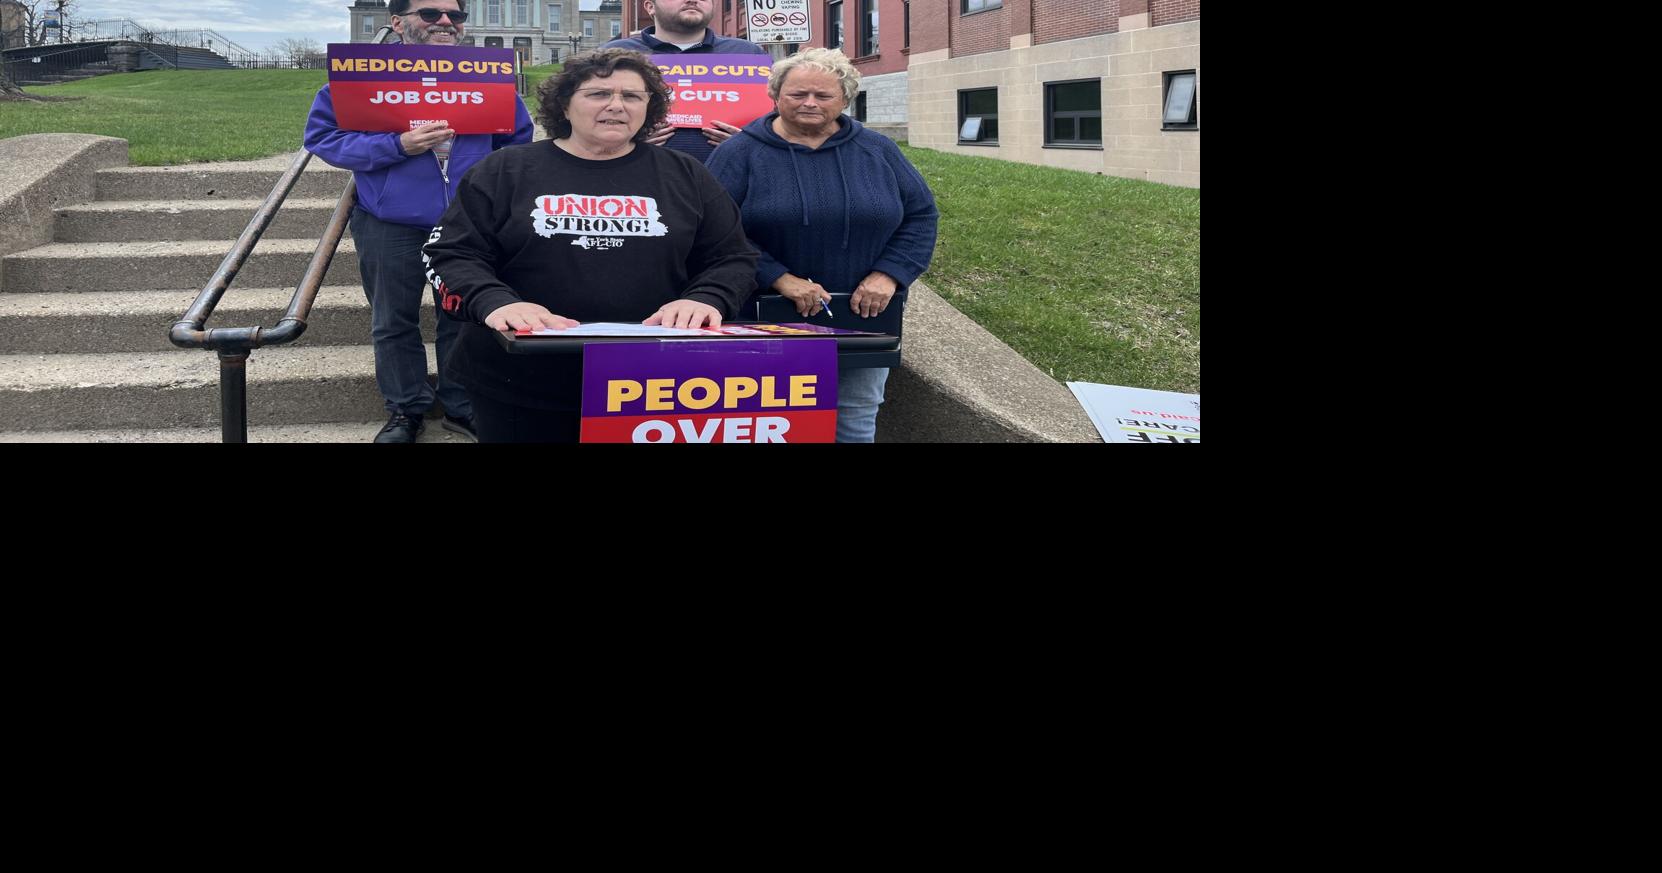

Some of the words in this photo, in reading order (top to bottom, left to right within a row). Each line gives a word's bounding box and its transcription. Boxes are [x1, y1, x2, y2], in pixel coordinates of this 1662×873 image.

[753, 0, 776, 10] NO
[331, 58, 454, 73] MEDICAID
[457, 60, 513, 75] CUTS
[657, 65, 709, 76] CAID
[712, 65, 771, 77] CUTS
[369, 91, 420, 104] JOB
[424, 91, 484, 104] CUTS
[680, 90, 740, 102] CUTS
[543, 197, 648, 217] UNION
[544, 216, 650, 233] STRONG!
[606, 374, 818, 412] PEOPLE
[631, 416, 791, 443] OVER
